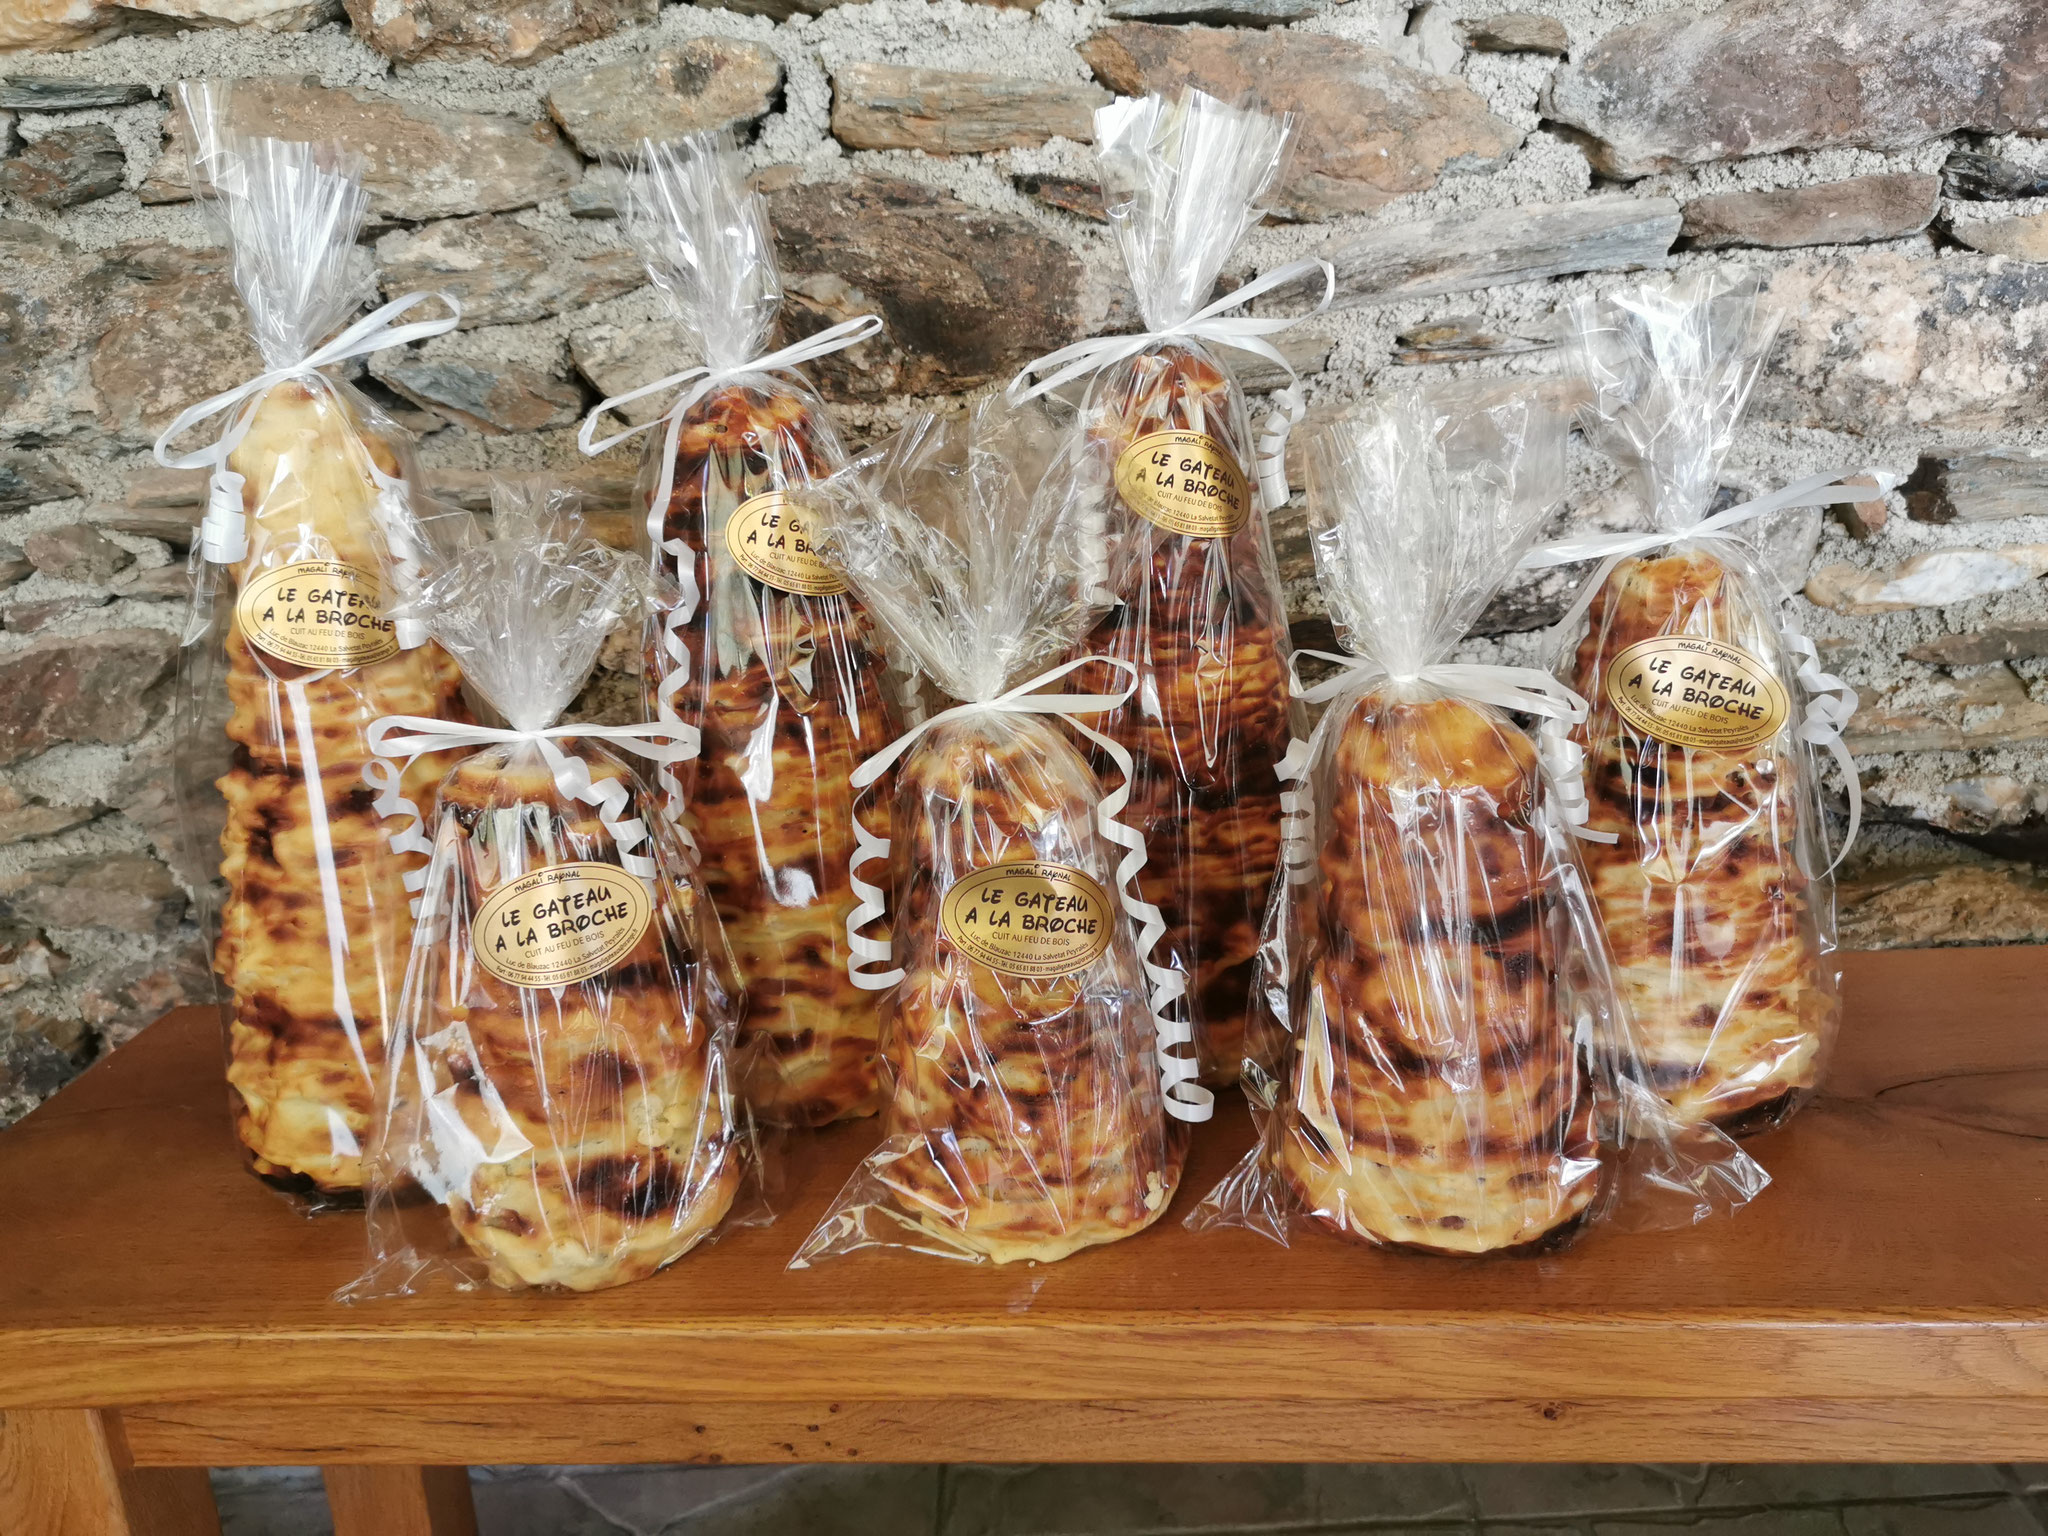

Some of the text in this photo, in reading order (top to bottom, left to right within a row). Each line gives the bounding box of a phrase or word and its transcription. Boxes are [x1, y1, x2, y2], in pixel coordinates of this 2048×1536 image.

[1136, 467, 1146, 482] A
[1156, 471, 1174, 488] LA
[1151, 451, 1234, 489] LE GATEAU
[1157, 490, 1172, 499] CUIT
[1173, 494, 1183, 502] AU
[1183, 496, 1196, 506] FEU
[1197, 499, 1207, 507] DE
[1208, 502, 1222, 512] BOIS
[761, 513, 781, 528] LE
[746, 529, 757, 544] A
[767, 533, 786, 550] LA
[769, 551, 785, 560] CUIT
[796, 556, 808, 565] FEU
[809, 559, 818, 567] DE
[277, 587, 297, 602] LE
[262, 606, 274, 622] A
[286, 607, 305, 624] LA
[290, 627, 366, 640] CUIT AU FEU DE BOIS
[1628, 673, 1642, 689] A
[1651, 679, 1673, 697] LA
[1649, 657, 1756, 698] LE GATEAU
[1651, 698, 1729, 724] CUIT AU FEU DE BOIS
[501, 885, 612, 928] LE GATEAU
[981, 887, 1088, 914] LE GATEAU
[964, 906, 977, 924] A
[989, 910, 1010, 928] LA
[495, 934, 507, 953] A
[516, 927, 538, 947] LA
[524, 930, 605, 959] CUIT AU FEU DE BOIS
[992, 931, 1070, 946] CUIT AU FEU DE BOIS
[551, 958, 573, 969] 12440
[1013, 951, 1033, 960] 12440
[1042, 951, 1066, 960] Salvetat
